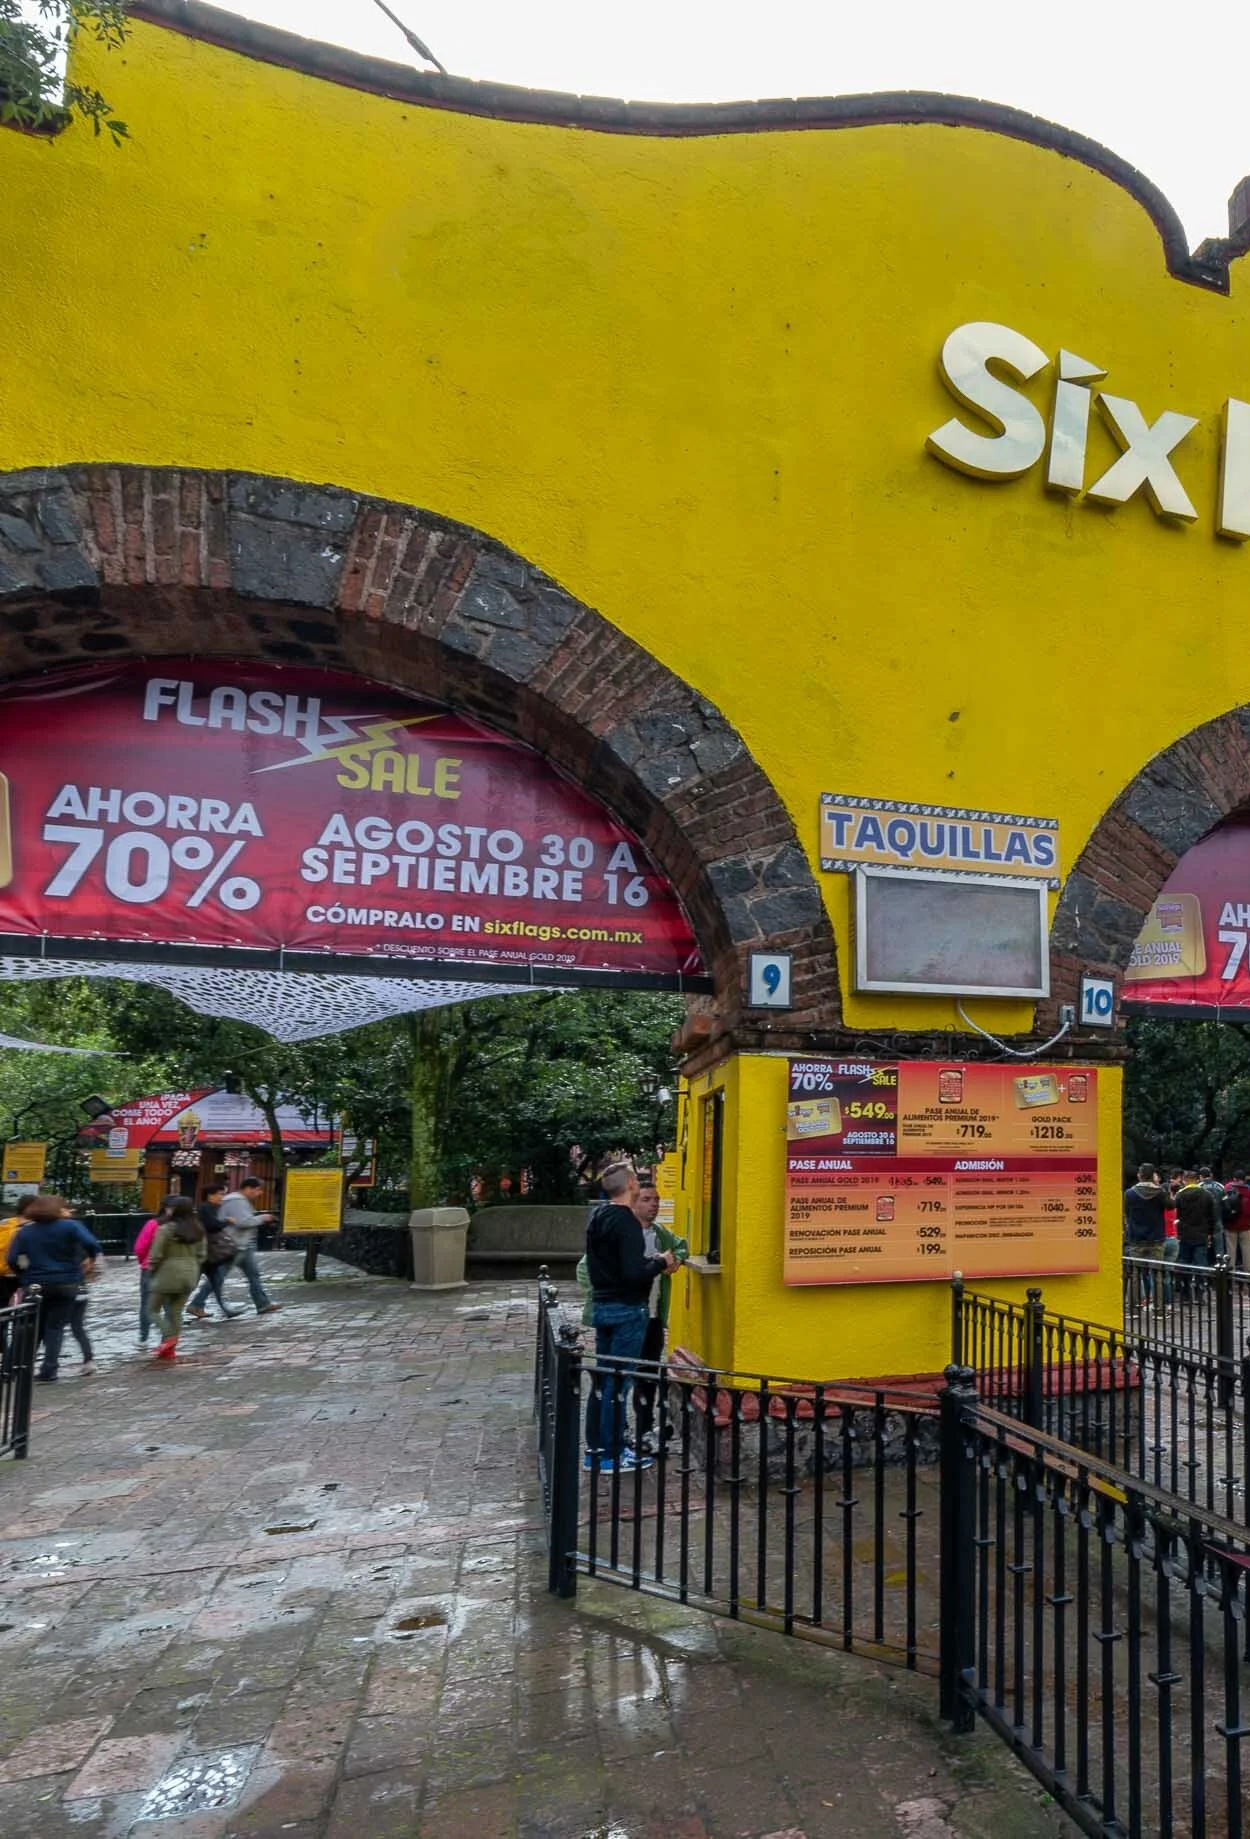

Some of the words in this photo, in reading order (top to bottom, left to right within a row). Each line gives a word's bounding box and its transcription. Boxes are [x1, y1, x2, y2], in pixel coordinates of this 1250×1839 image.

[143, 678, 321, 738] FLASH
[336, 750, 462, 799] SALE
[46, 783, 264, 838] AHORRA
[318, 814, 524, 863] AGOSTO
[541, 834, 594, 869] 30
[607, 841, 637, 873] A
[826, 811, 1055, 867] TAQUILLAS
[43, 824, 262, 911] 70%
[301, 847, 583, 903] SEPTIEMBRE
[603, 873, 649, 907] 16
[306, 902, 444, 931] CÓMPRALO
[452, 915, 480, 933] EN
[484, 920, 642, 944] sixflags.com.mx
[384, 943, 435, 955] DESCUENTO
[467, 948, 476, 957] EL
[479, 949, 498, 959] PASE
[500, 951, 529, 961] ANUAL
[530, 952, 554, 962] GOLD
[1144, 941, 1182, 954] ANUAL
[1128, 953, 1152, 967] OLD
[1154, 953, 1180, 966] 2019
[762, 963, 781, 995] 9
[1085, 987, 1113, 1016] 10
[792, 1064, 833, 1073] AHORRA
[838, 1065, 871, 1075] FLASH
[873, 1075, 897, 1085] SALE
[792, 1073, 833, 1091] 70%
[145, 1109, 173, 1117] TODO
[789, 1161, 816, 1170] PASE
[817, 1161, 853, 1170] ANUAL
[954, 1159, 1005, 1170] ADMISIÓN
